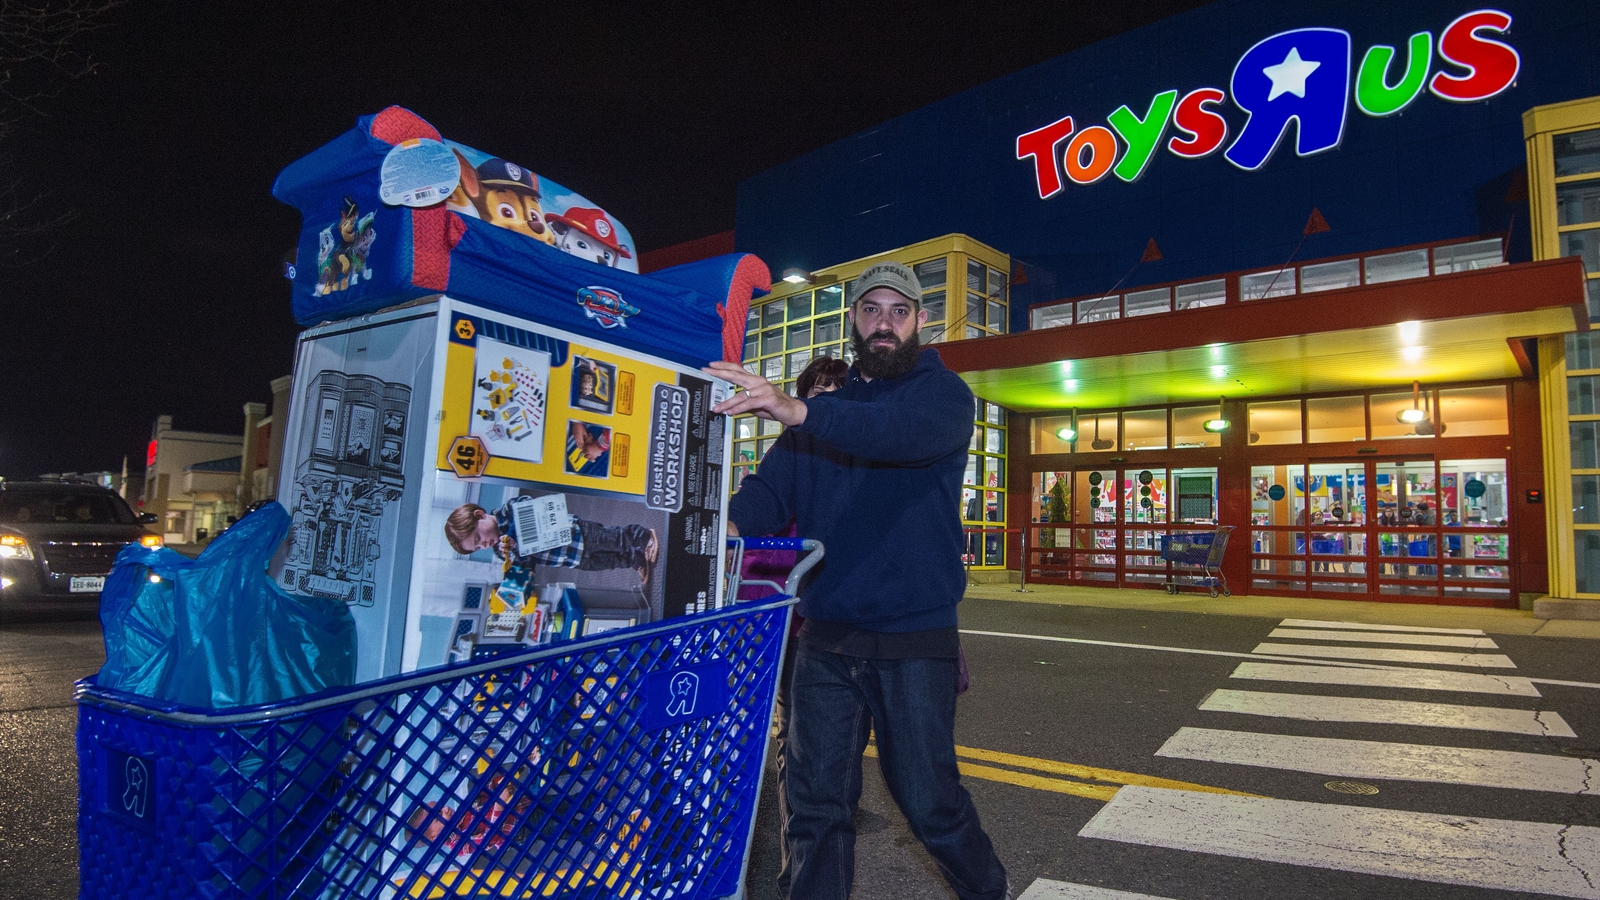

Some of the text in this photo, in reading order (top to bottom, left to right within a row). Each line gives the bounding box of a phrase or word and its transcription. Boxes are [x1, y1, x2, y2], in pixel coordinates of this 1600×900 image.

[883, 265, 909, 282] SEALS
[459, 321, 471, 336] 3+
[456, 444, 476, 471] 46
[652, 401, 668, 493] just like home
[664, 391, 684, 506] WORKSHOP
[547, 501, 557, 526] 129.99
